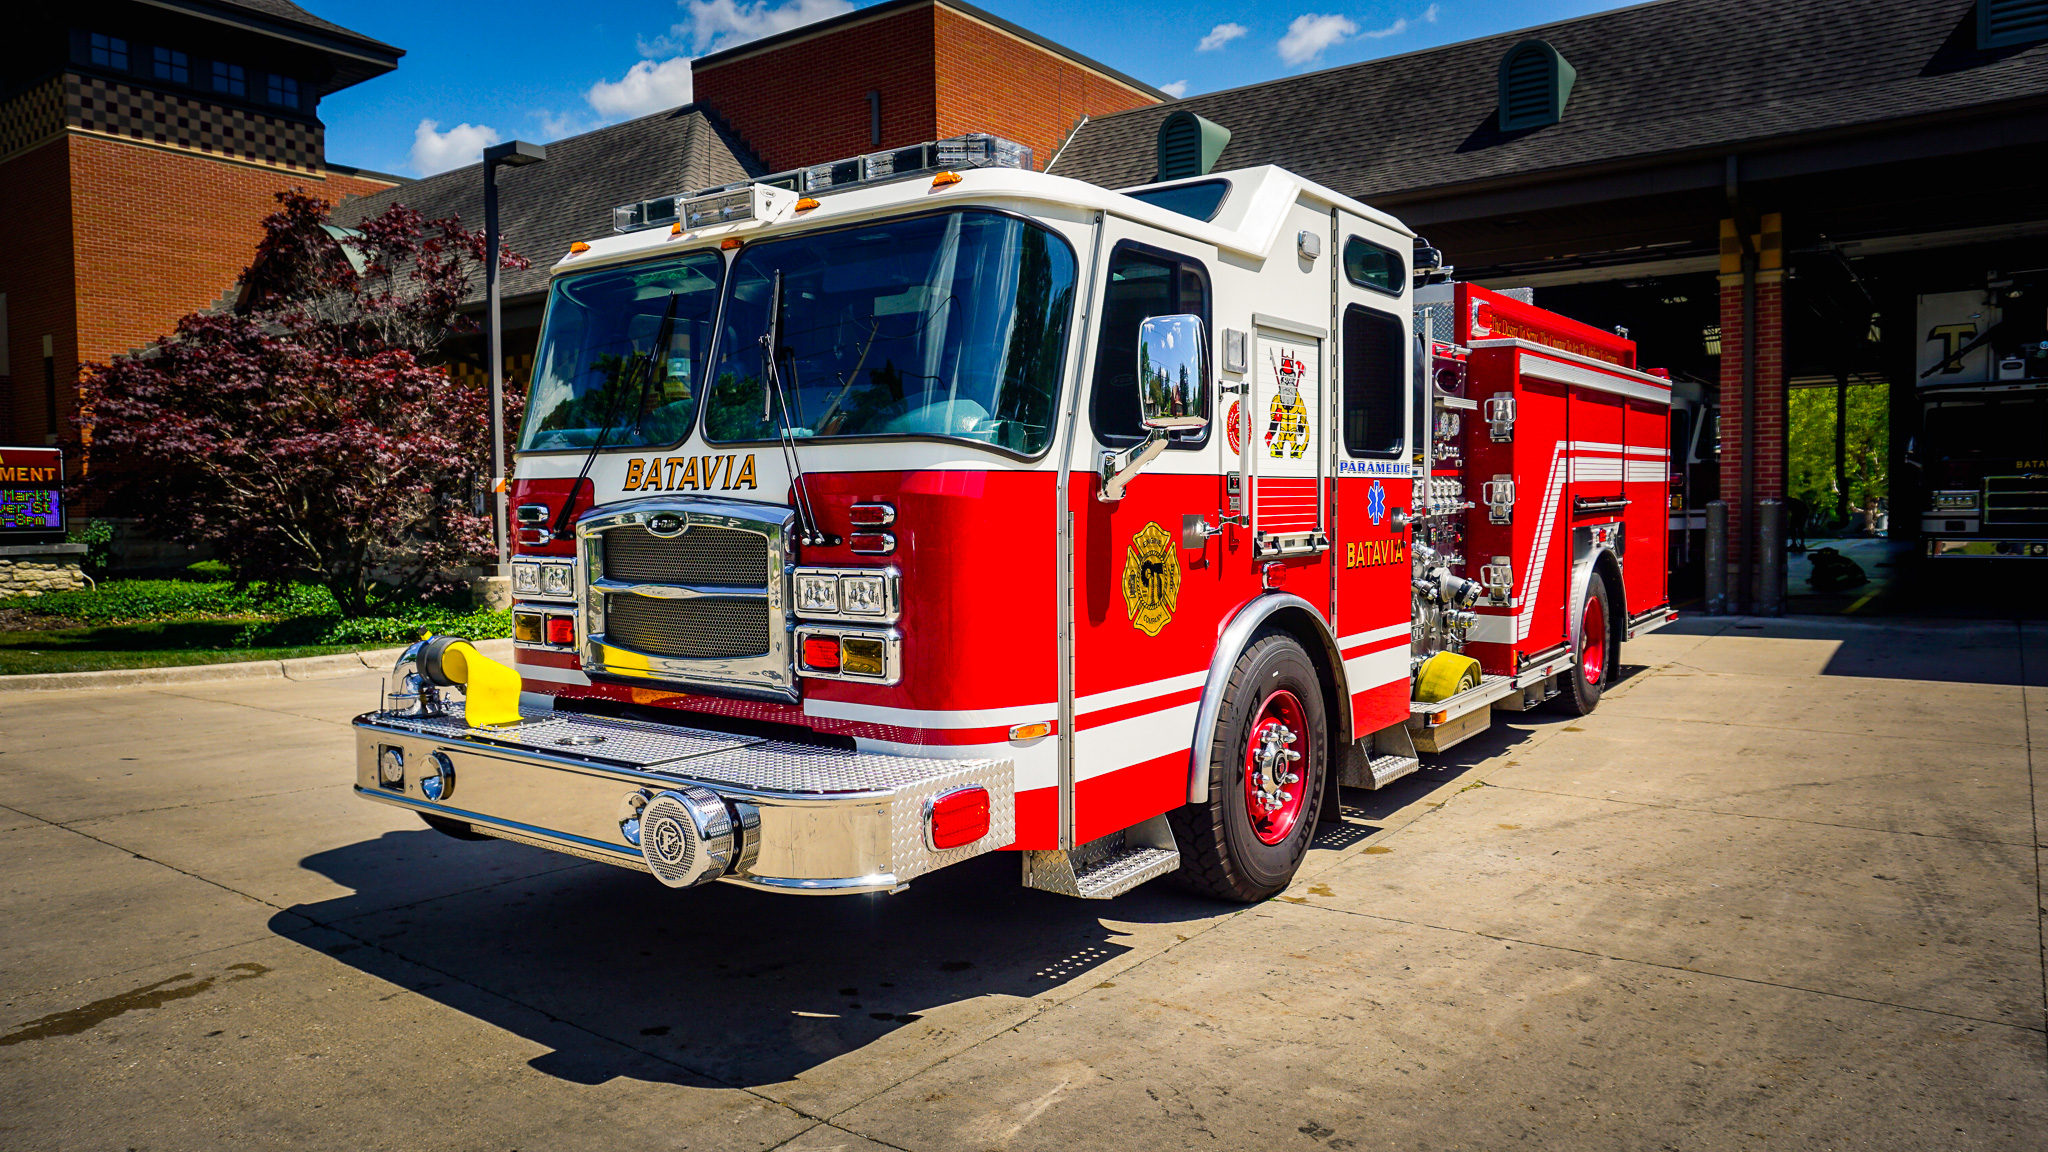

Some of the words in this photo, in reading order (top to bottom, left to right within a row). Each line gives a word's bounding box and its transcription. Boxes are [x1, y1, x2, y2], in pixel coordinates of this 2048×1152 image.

[622, 454, 758, 491] BATAVIA
[1339, 460, 1411, 475] PARAMEDIC
[3, 489, 51, 502] Markt
[33, 501, 52, 514] St
[1346, 539, 1404, 569] BATAVIA
